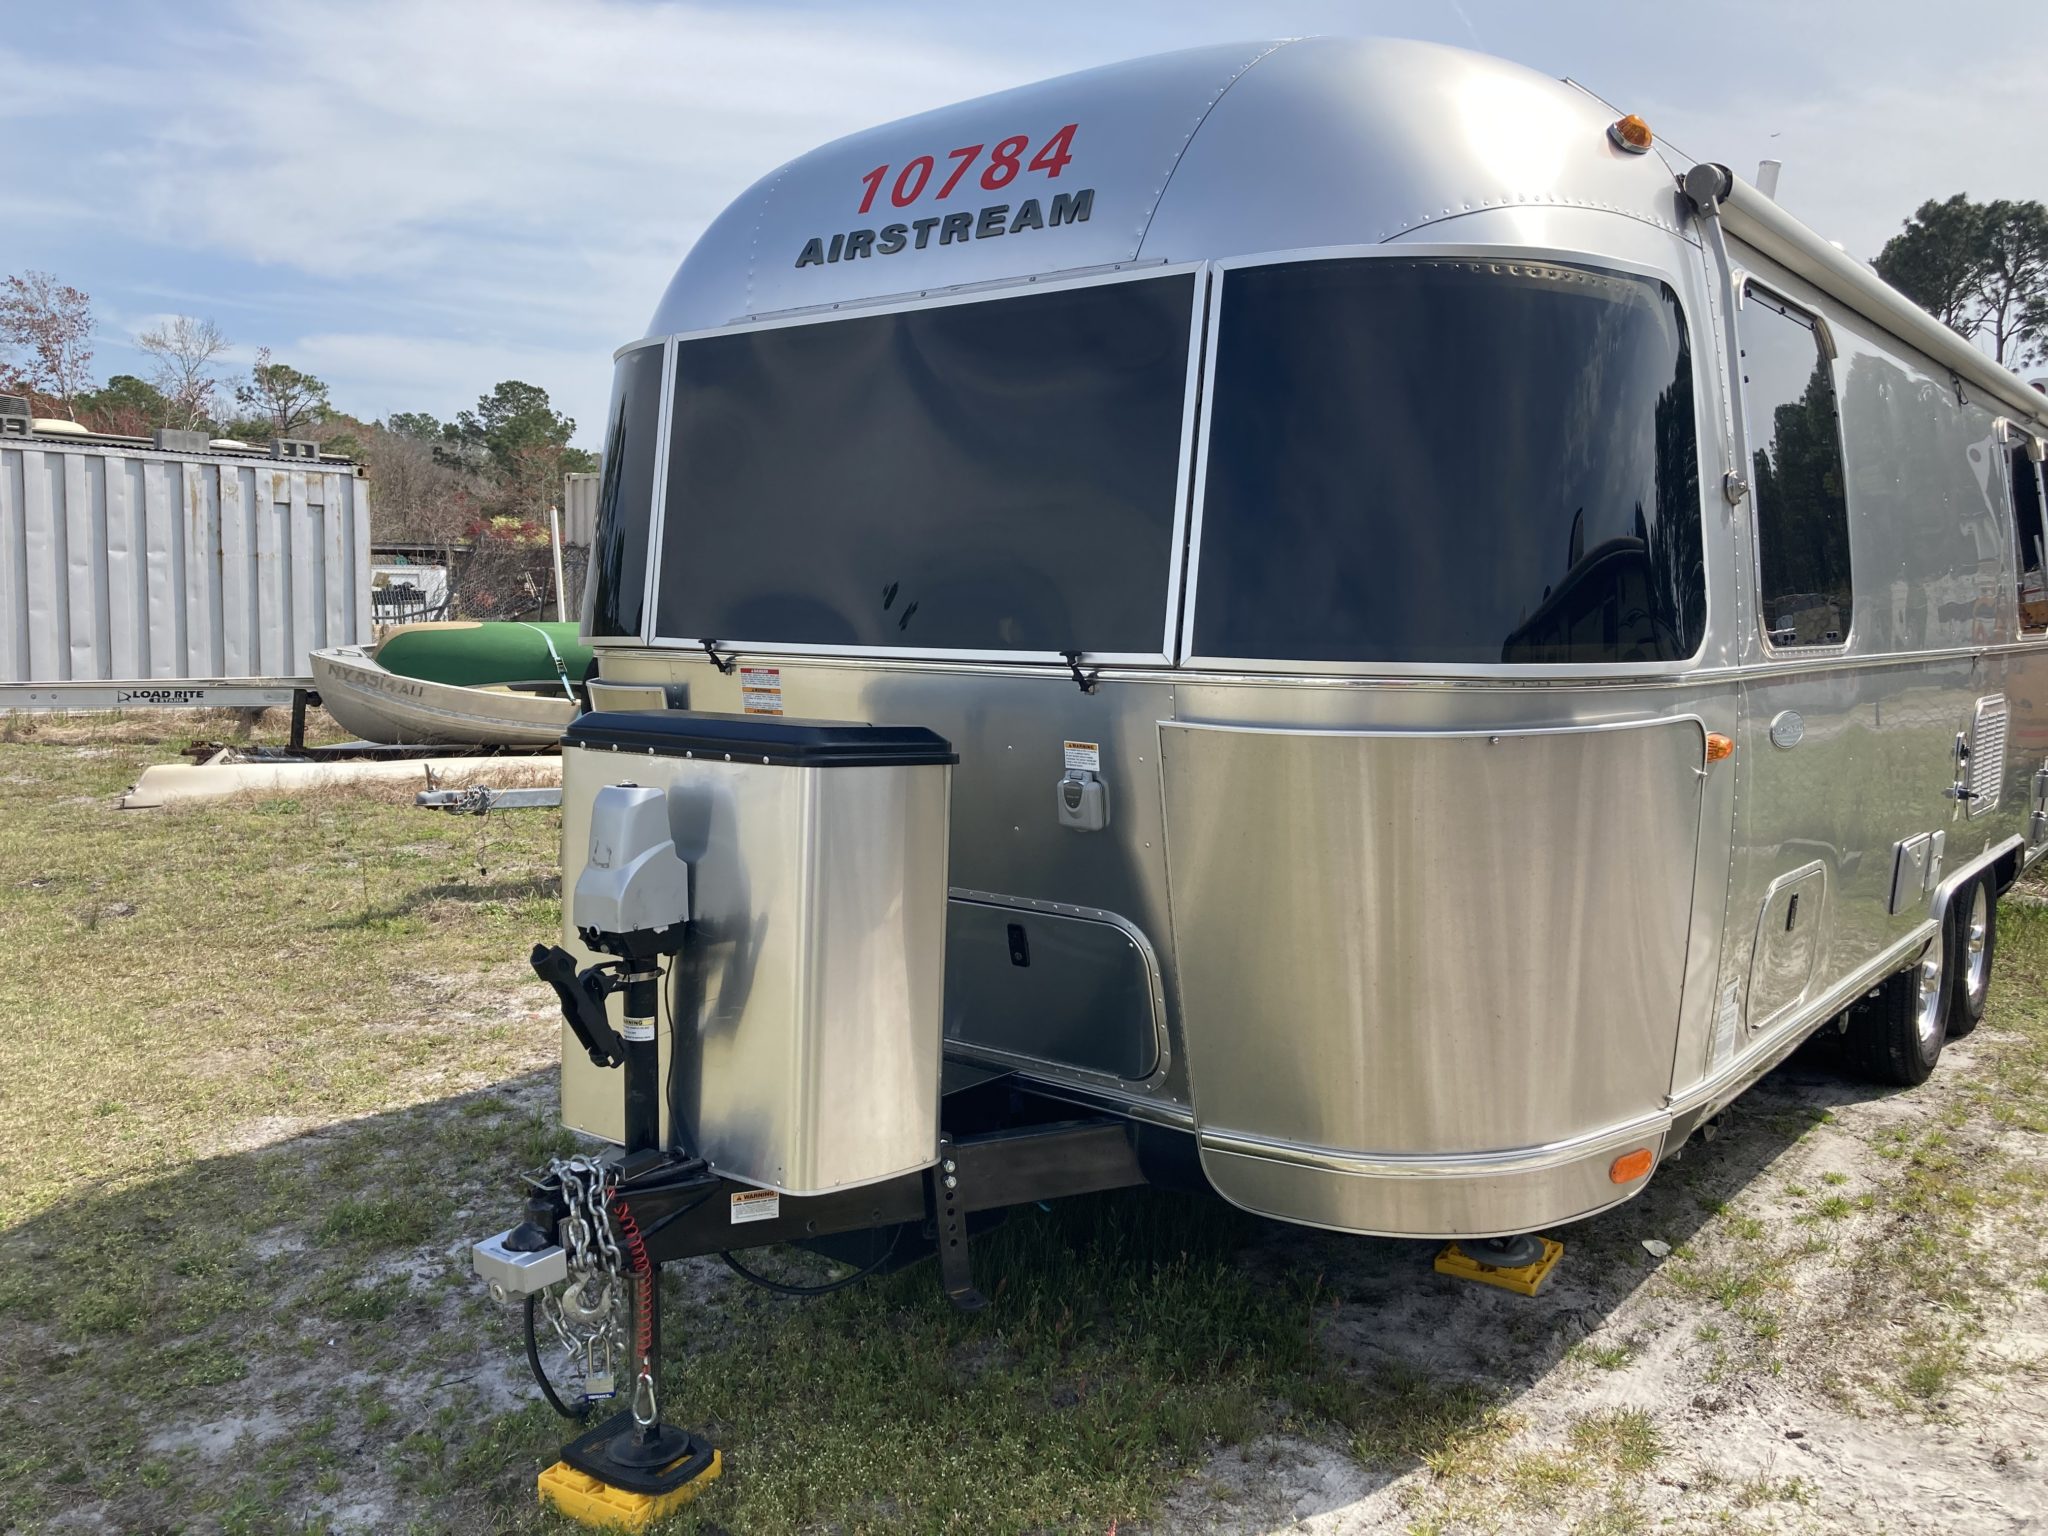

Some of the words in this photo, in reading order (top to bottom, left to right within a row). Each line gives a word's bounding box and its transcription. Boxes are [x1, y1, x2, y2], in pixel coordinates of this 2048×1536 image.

[858, 123, 1079, 214] 10784
[795, 188, 1095, 268] AIRSTREAM
[133, 690, 171, 698] LOAD
[174, 690, 204, 698] RITE
[744, 1191, 775, 1200] WARNING
